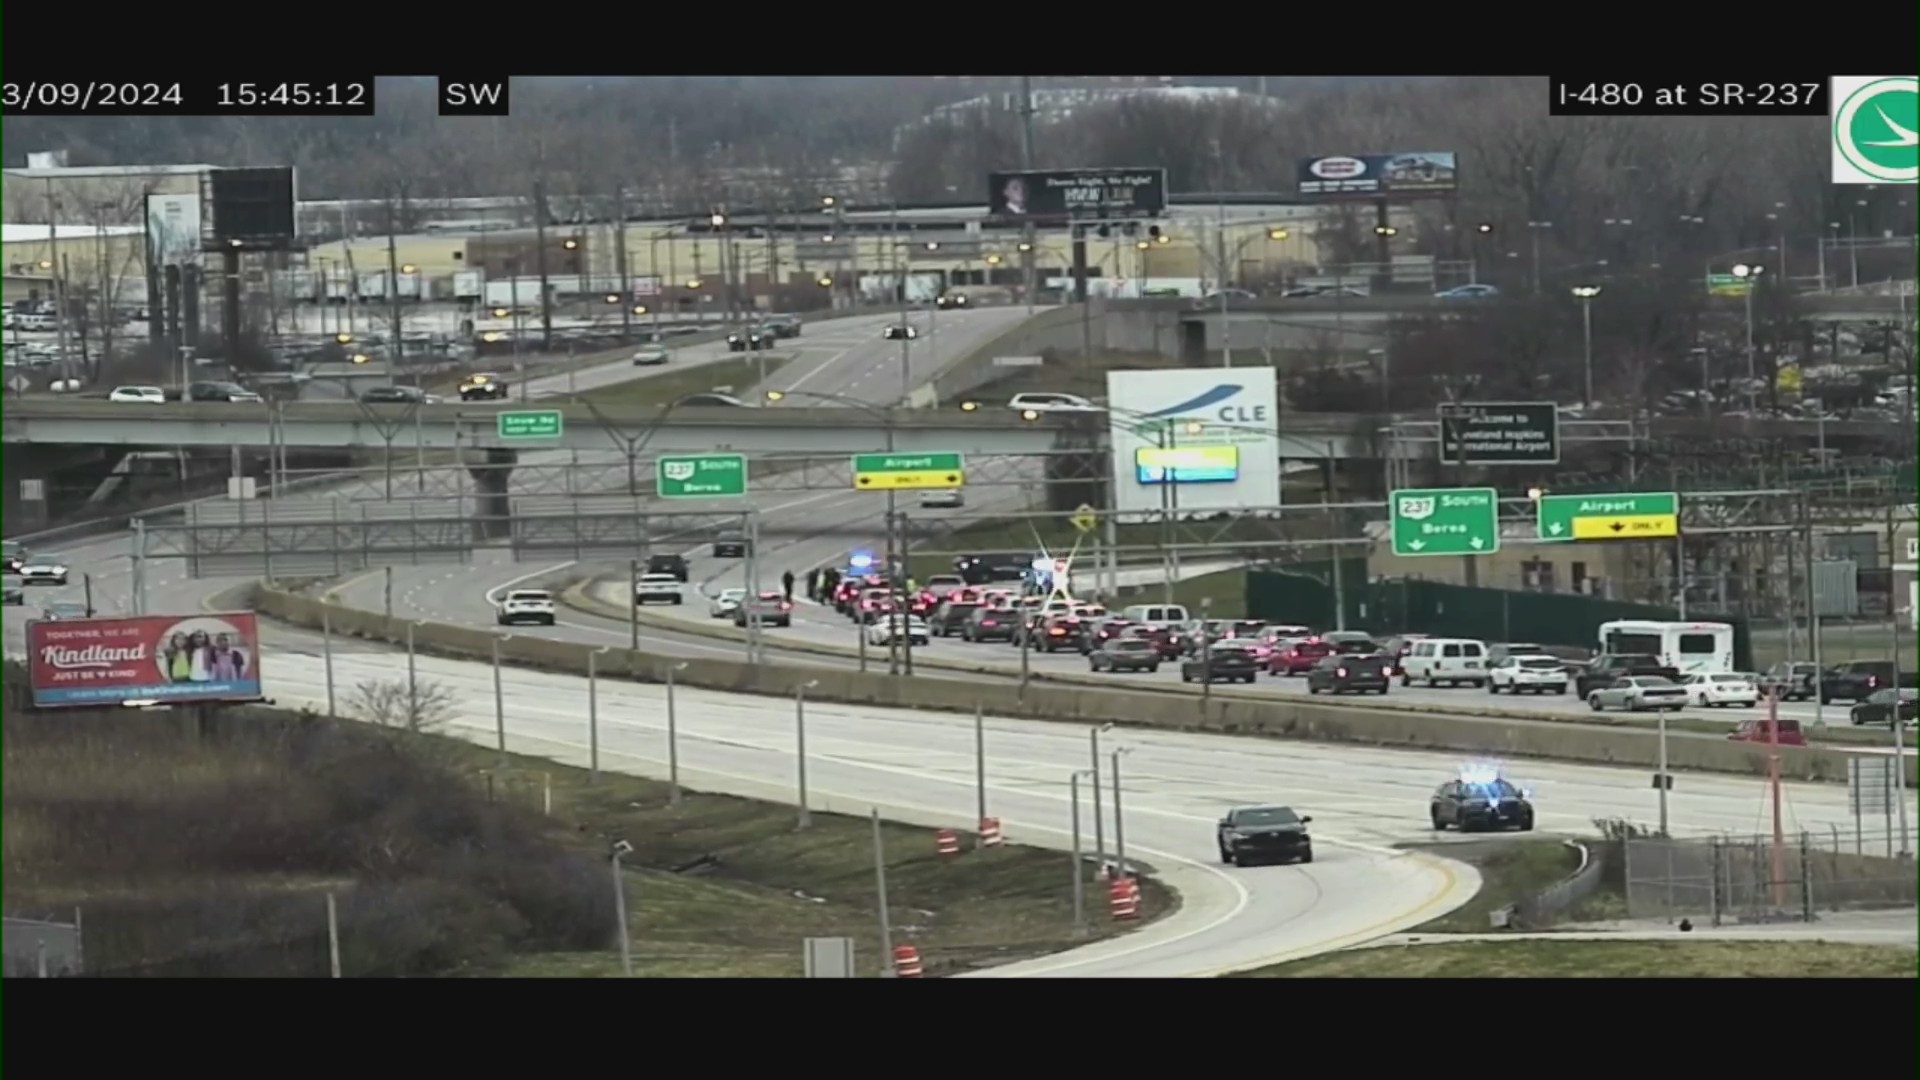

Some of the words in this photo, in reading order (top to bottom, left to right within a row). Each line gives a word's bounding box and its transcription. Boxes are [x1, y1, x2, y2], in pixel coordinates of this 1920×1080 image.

[1218, 405, 1267, 422] CLE
[1469, 414, 1513, 424] elcome
[1446, 442, 1513, 452] Inrnational
[884, 457, 933, 469] Airport
[1404, 499, 1433, 514] 237
[1580, 499, 1637, 513] Airport
[1423, 522, 1467, 534] Berea
[41, 643, 146, 669] Kindland
[52, 672, 78, 682] JUST
[81, 670, 96, 680] BE
[109, 670, 137, 679] KIND
